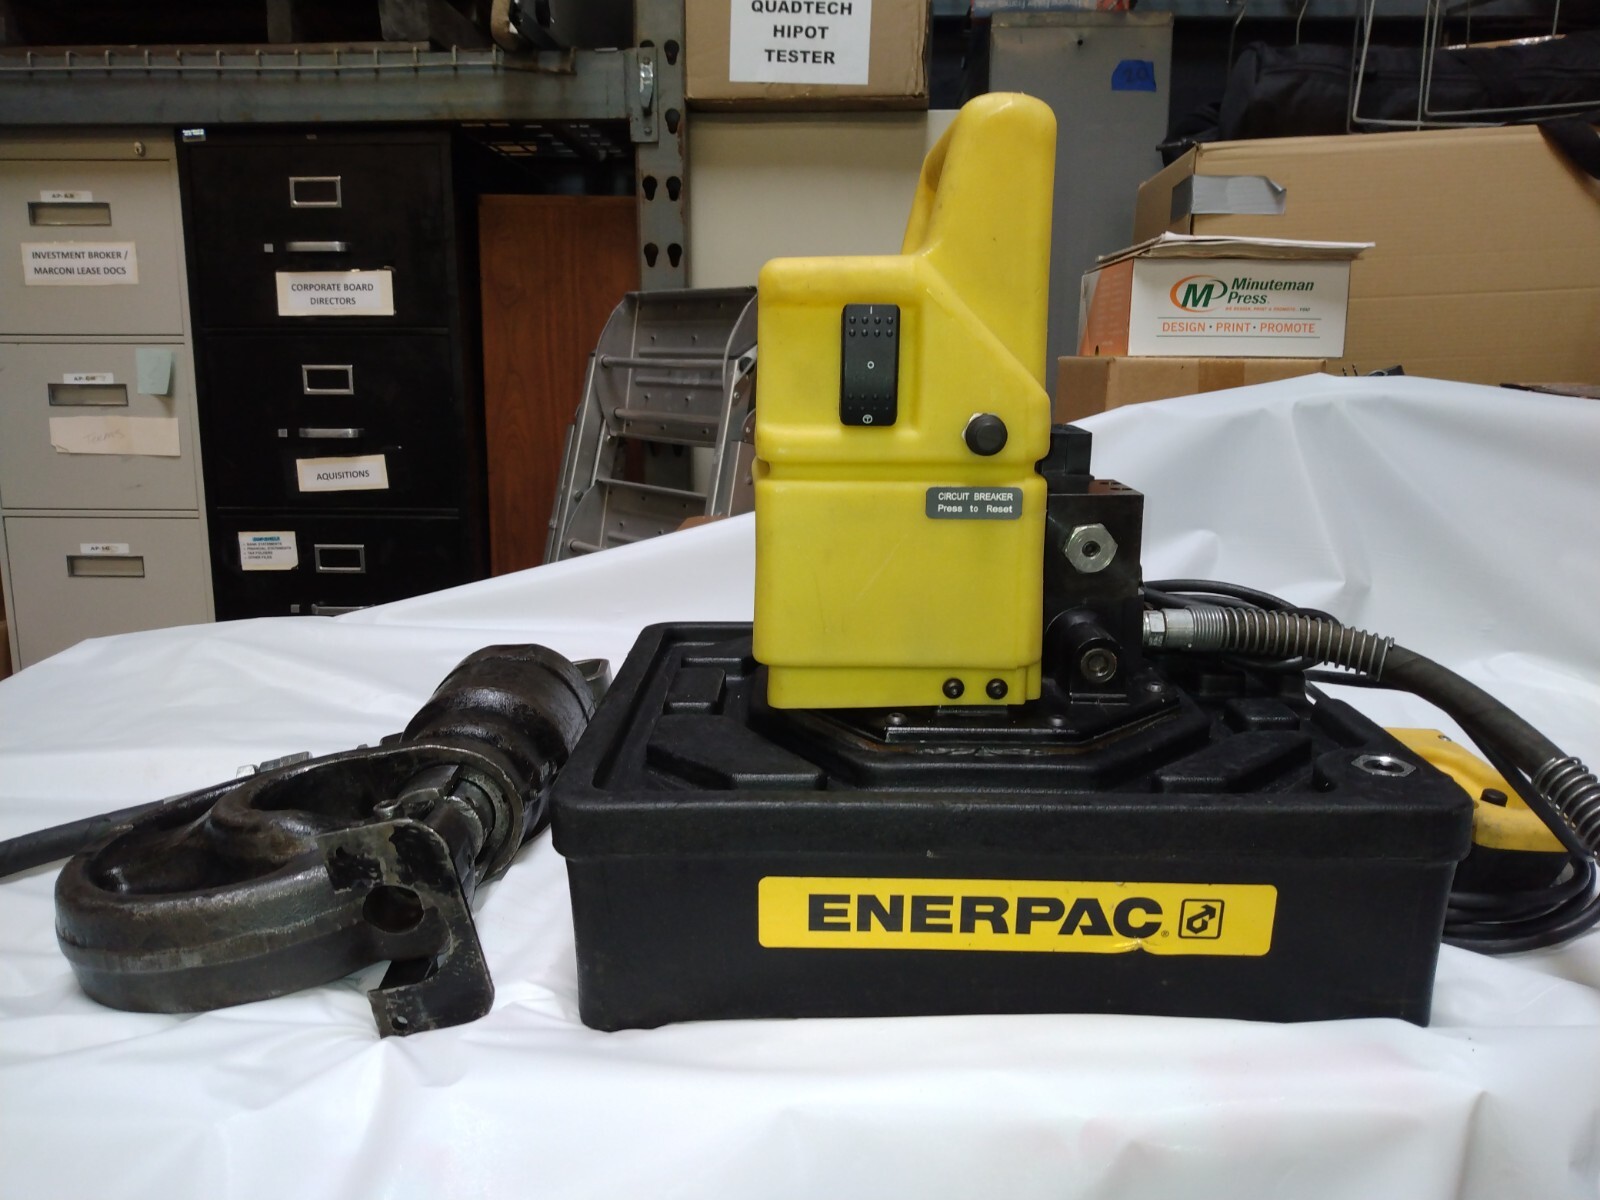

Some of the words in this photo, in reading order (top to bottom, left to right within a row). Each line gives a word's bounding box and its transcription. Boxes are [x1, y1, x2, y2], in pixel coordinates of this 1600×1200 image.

[751, 0, 853, 15] QUADTECH
[773, 24, 829, 39] HIPOT
[764, 49, 835, 64] TESTER
[32, 251, 86, 260] INVESTMENT
[88, 251, 122, 260] BROKER
[34, 266, 75, 275] MARCONI
[77, 267, 101, 275] LEASE
[103, 267, 127, 275] DOCS
[291, 283, 342, 292] CORPORATE
[343, 283, 374, 292] BOARD
[1231, 277, 1315, 291] Minuteman
[310, 297, 356, 305] DIRECTORS
[1227, 291, 1268, 304] Press
[1162, 321, 1206, 332] DESIGN
[1216, 322, 1251, 333] PRINT
[1260, 322, 1316, 333] PROMOTE
[316, 469, 370, 481] AQUISITIONS
[938, 492, 970, 501] CIRCUIT
[974, 492, 1014, 501] BREAKER
[937, 504, 963, 513] Press
[970, 505, 979, 513] to
[986, 504, 1013, 513] Reset
[808, 893, 1163, 938] ENERPAC
